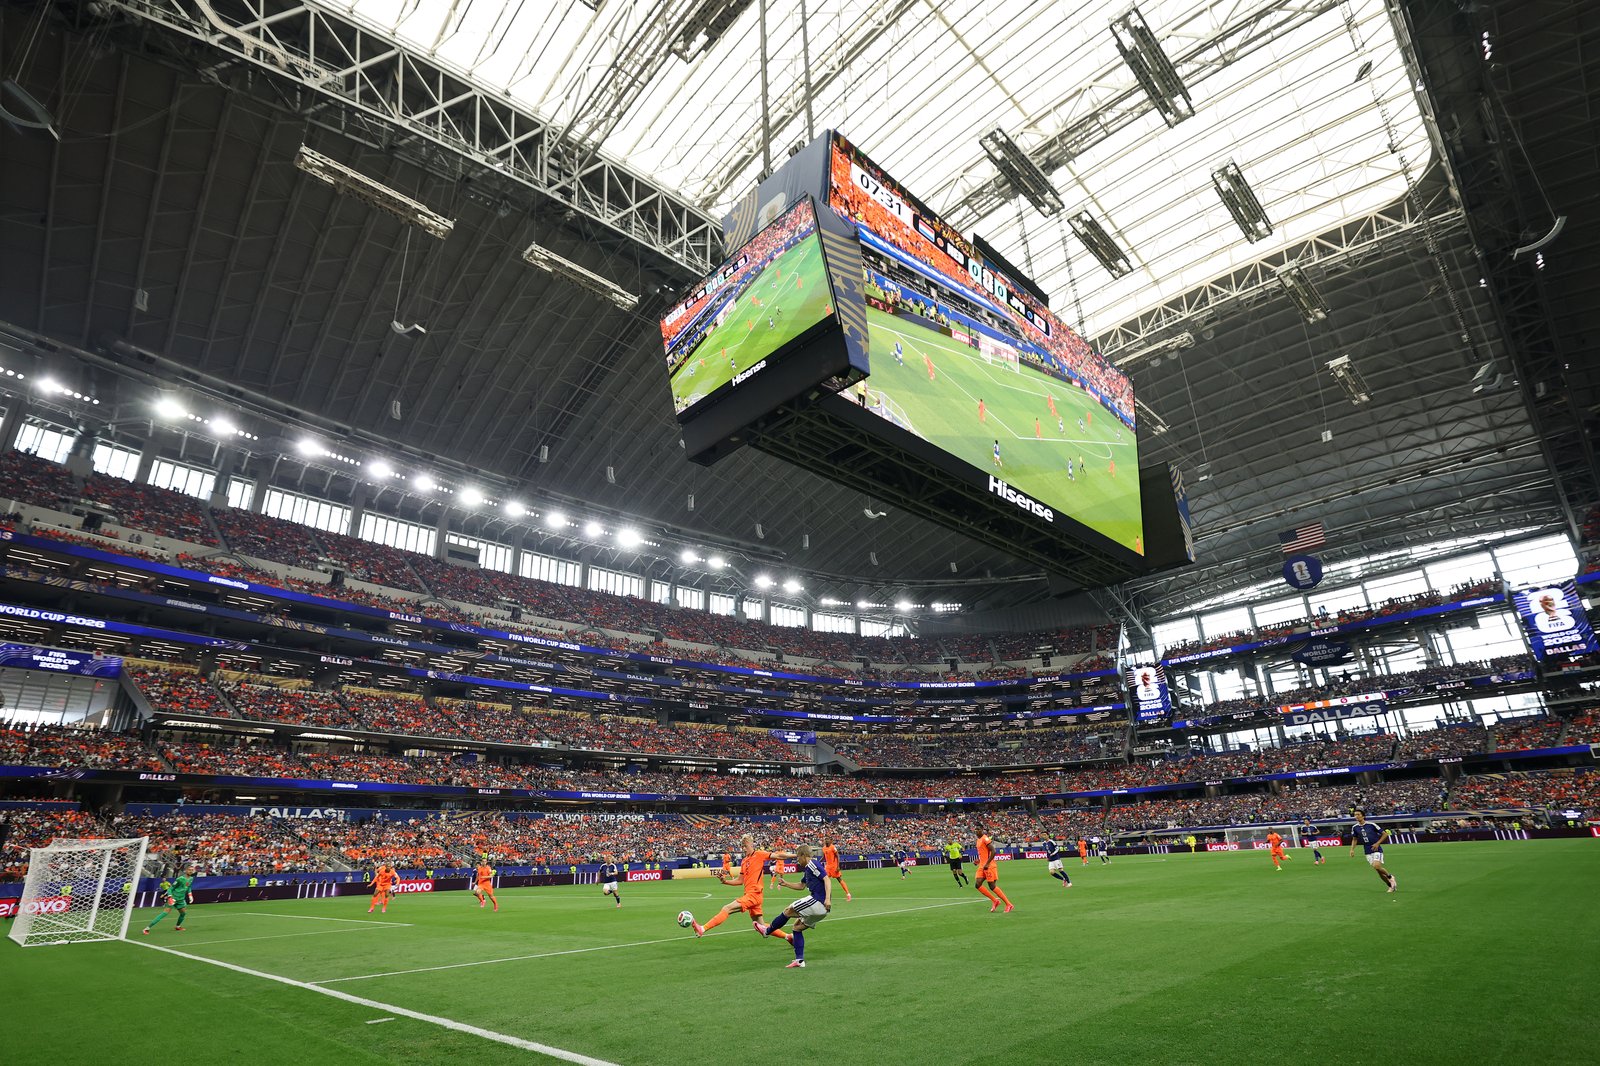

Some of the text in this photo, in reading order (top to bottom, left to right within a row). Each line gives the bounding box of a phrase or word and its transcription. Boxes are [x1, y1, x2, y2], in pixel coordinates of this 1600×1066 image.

[860, 174, 901, 216] 07:31
[732, 360, 766, 386] Hisense
[989, 474, 1054, 522] Hisense
[41, 612, 65, 621] CUP
[65, 616, 106, 628] 2026
[389, 612, 422, 623] DALLAS
[1311, 627, 1338, 637] DALLAS
[372, 636, 409, 646] DALLAS
[509, 634, 523, 642] FIFA
[523, 637, 546, 645] WORLD
[1543, 634, 1582, 646] 2026
[1545, 644, 1587, 655] DALLAS
[33, 655, 62, 664] WORLD
[320, 656, 353, 666] DALLAS
[1180, 654, 1200, 663] WORLD
[1212, 648, 1232, 656] 2026
[39, 662, 68, 670] 2026
[1436, 681, 1466, 690] DALLAS
[1293, 704, 1382, 724] DALLAS
[627, 872, 660, 882] Lenovo
